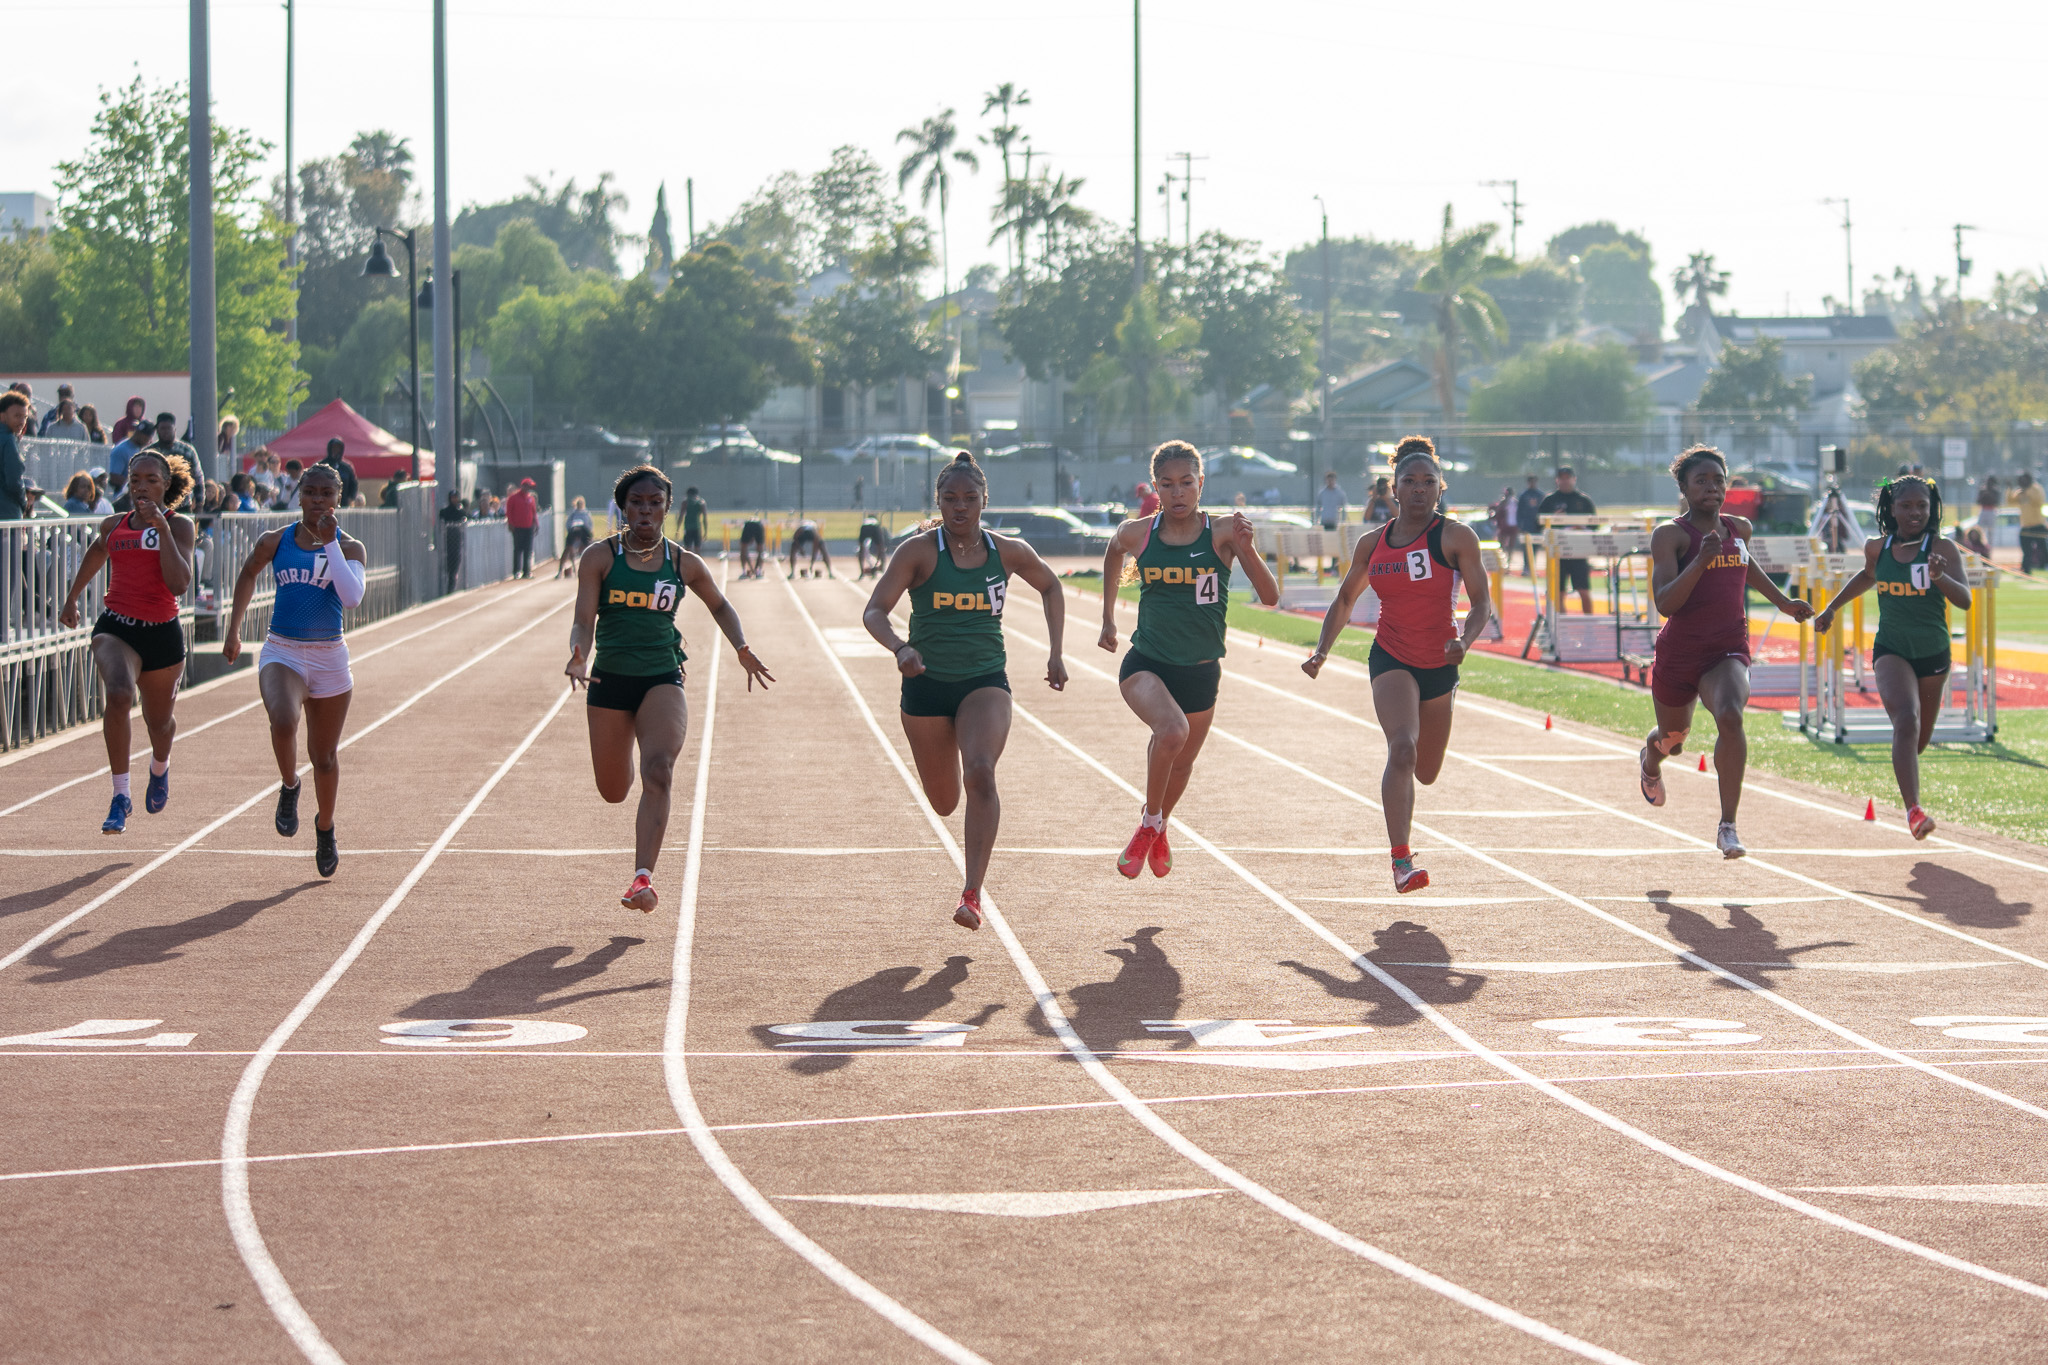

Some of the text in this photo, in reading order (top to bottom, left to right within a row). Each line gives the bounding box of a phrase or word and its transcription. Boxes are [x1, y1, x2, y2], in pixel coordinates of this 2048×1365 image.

[145, 528, 158, 548] 8
[319, 555, 330, 578] 7
[1412, 552, 1427, 579] 3
[1707, 554, 1747, 570] WILSO
[1200, 575, 1215, 602] 4
[1916, 565, 1925, 588] 1
[656, 585, 672, 611] 6
[993, 584, 1004, 614] 5
[0, 1019, 198, 1047] 7
[767, 1019, 981, 1048] 5
[1140, 1019, 1374, 1047] 4
[1531, 1016, 1763, 1046] 3
